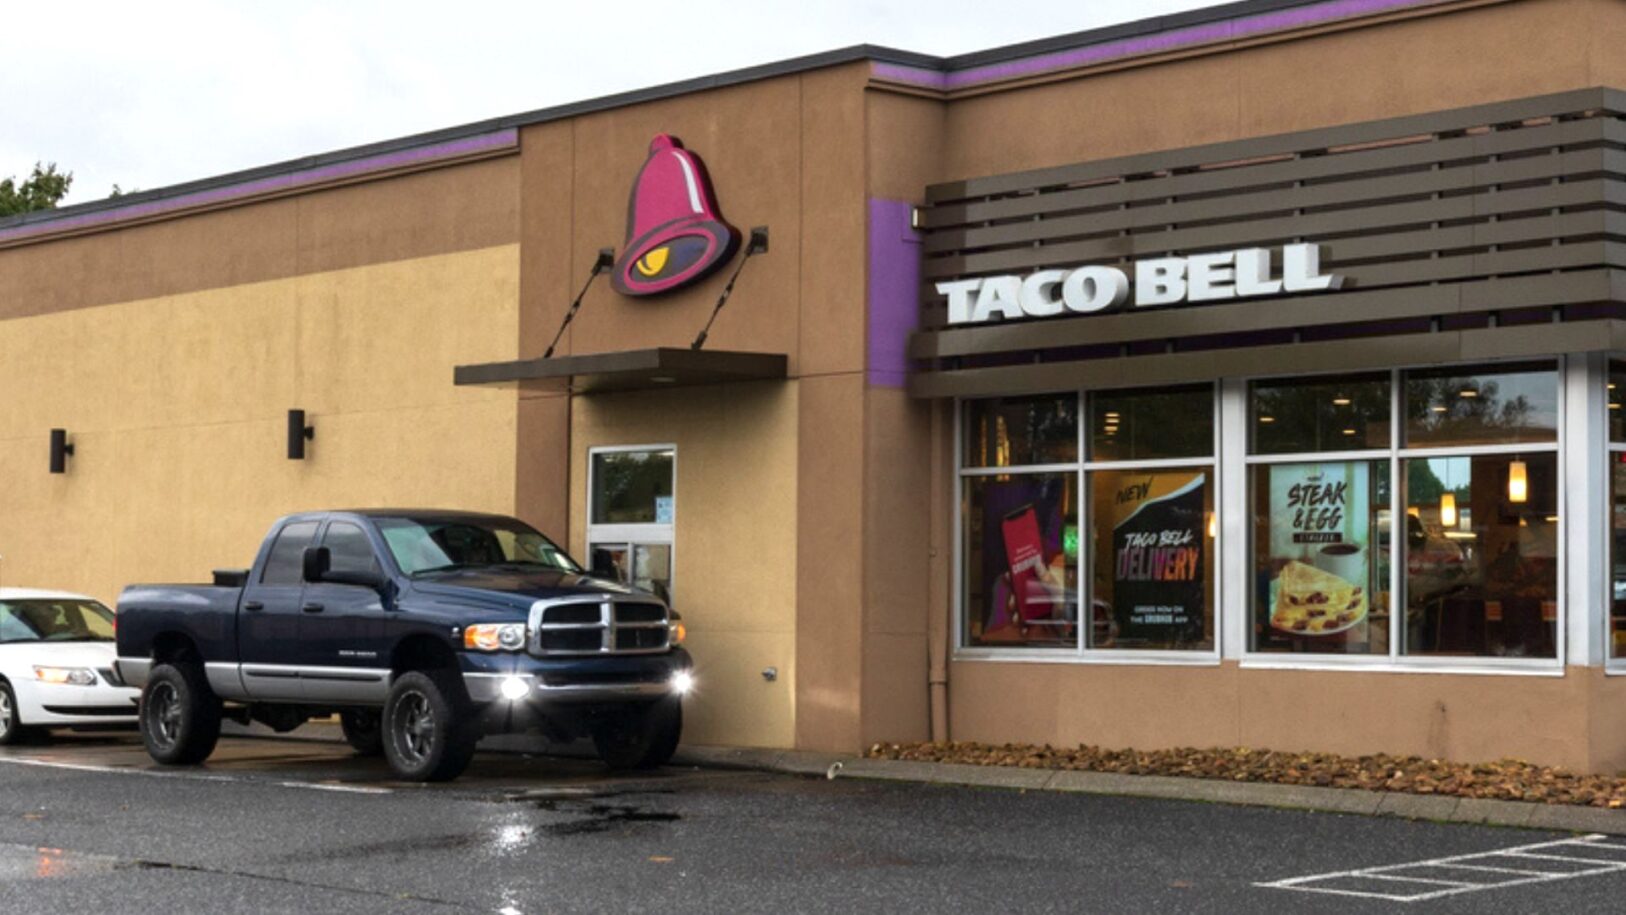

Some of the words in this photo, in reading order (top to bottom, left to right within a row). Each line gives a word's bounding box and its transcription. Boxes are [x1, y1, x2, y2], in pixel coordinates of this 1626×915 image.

[936, 265, 1128, 325] TACO
[1135, 243, 1335, 306] BELL
[1116, 476, 1153, 504] NEW
[1287, 481, 1348, 507] STEAK
[1125, 531, 1157, 551] TACO
[1158, 529, 1193, 546] BELL
[1116, 548, 1199, 581] DELIVERY
